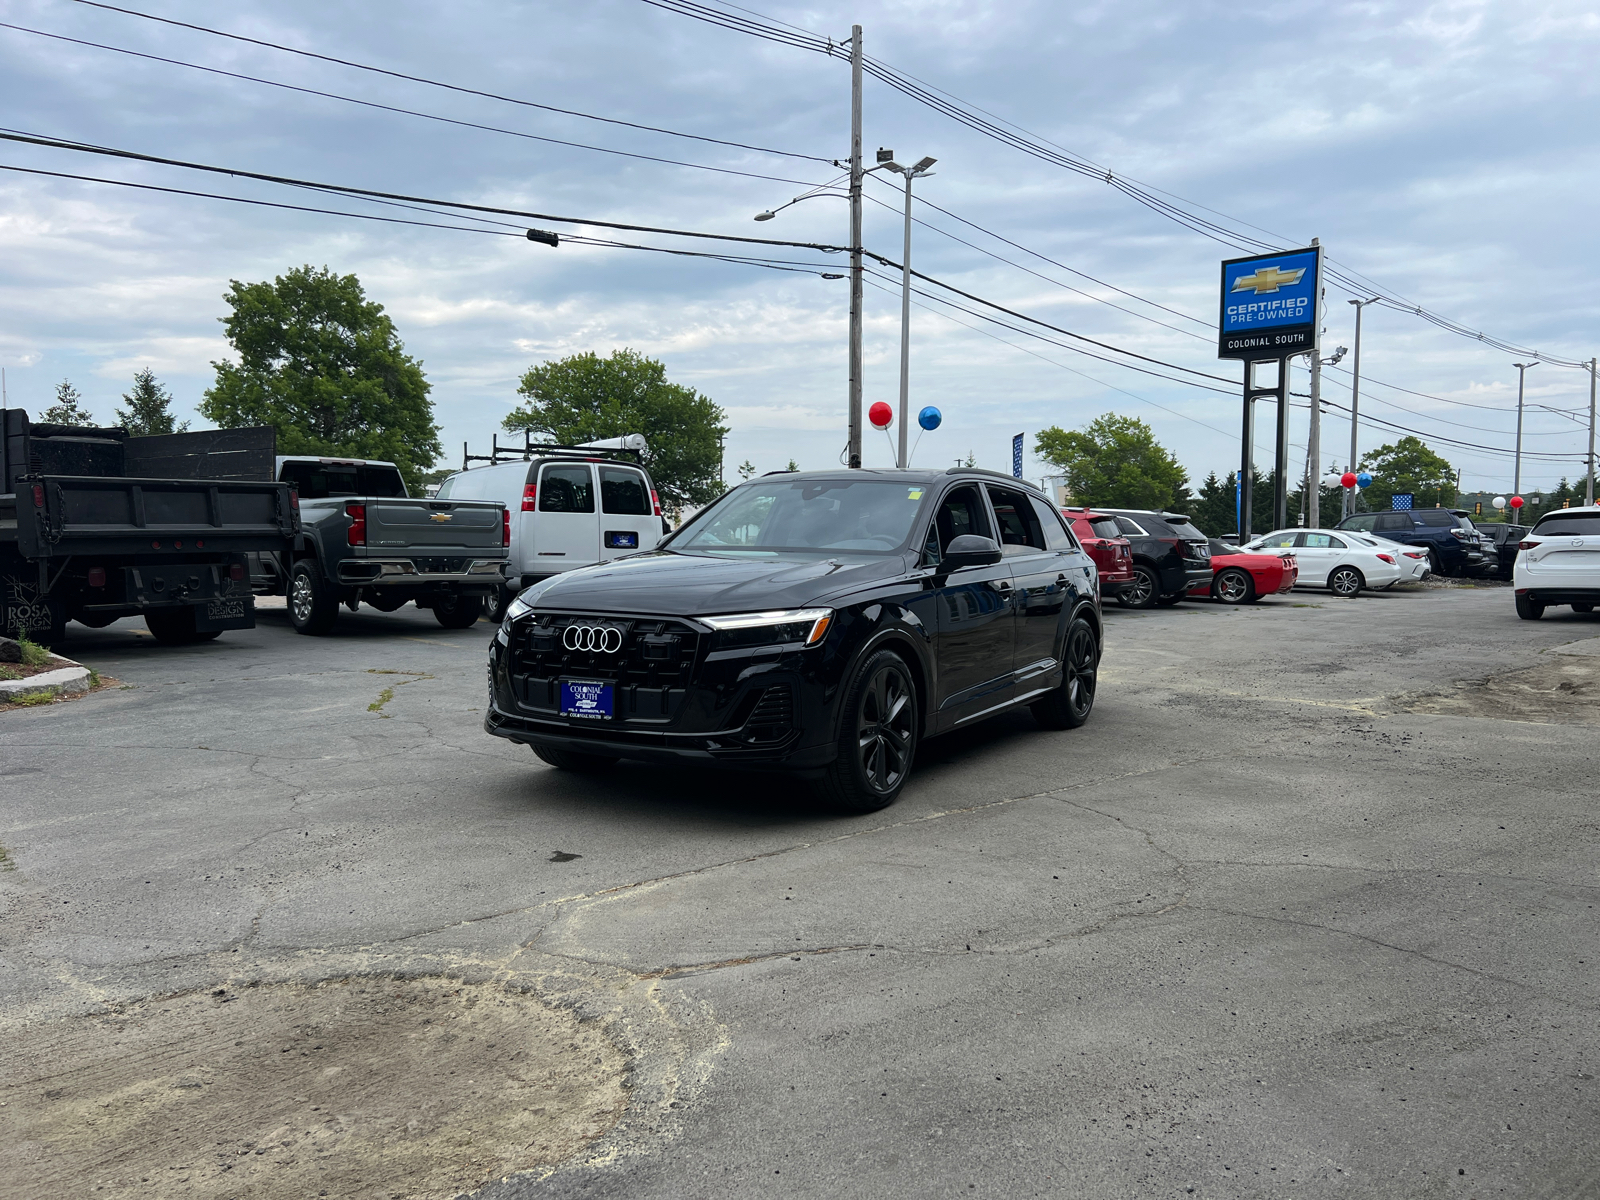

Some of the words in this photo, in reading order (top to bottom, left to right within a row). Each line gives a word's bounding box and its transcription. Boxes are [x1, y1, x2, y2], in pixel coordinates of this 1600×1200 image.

[1227, 297, 1308, 315] CERTIFIED
[1230, 307, 1304, 324] PRE-OWNED
[1228, 337, 1270, 349] COLONIAL
[1275, 333, 1304, 345] SOUTH
[8, 604, 51, 619] ROSA
[207, 605, 245, 616] DESIGN
[7, 617, 52, 629] DESIGN
[570, 685, 603, 694] COLONIAL
